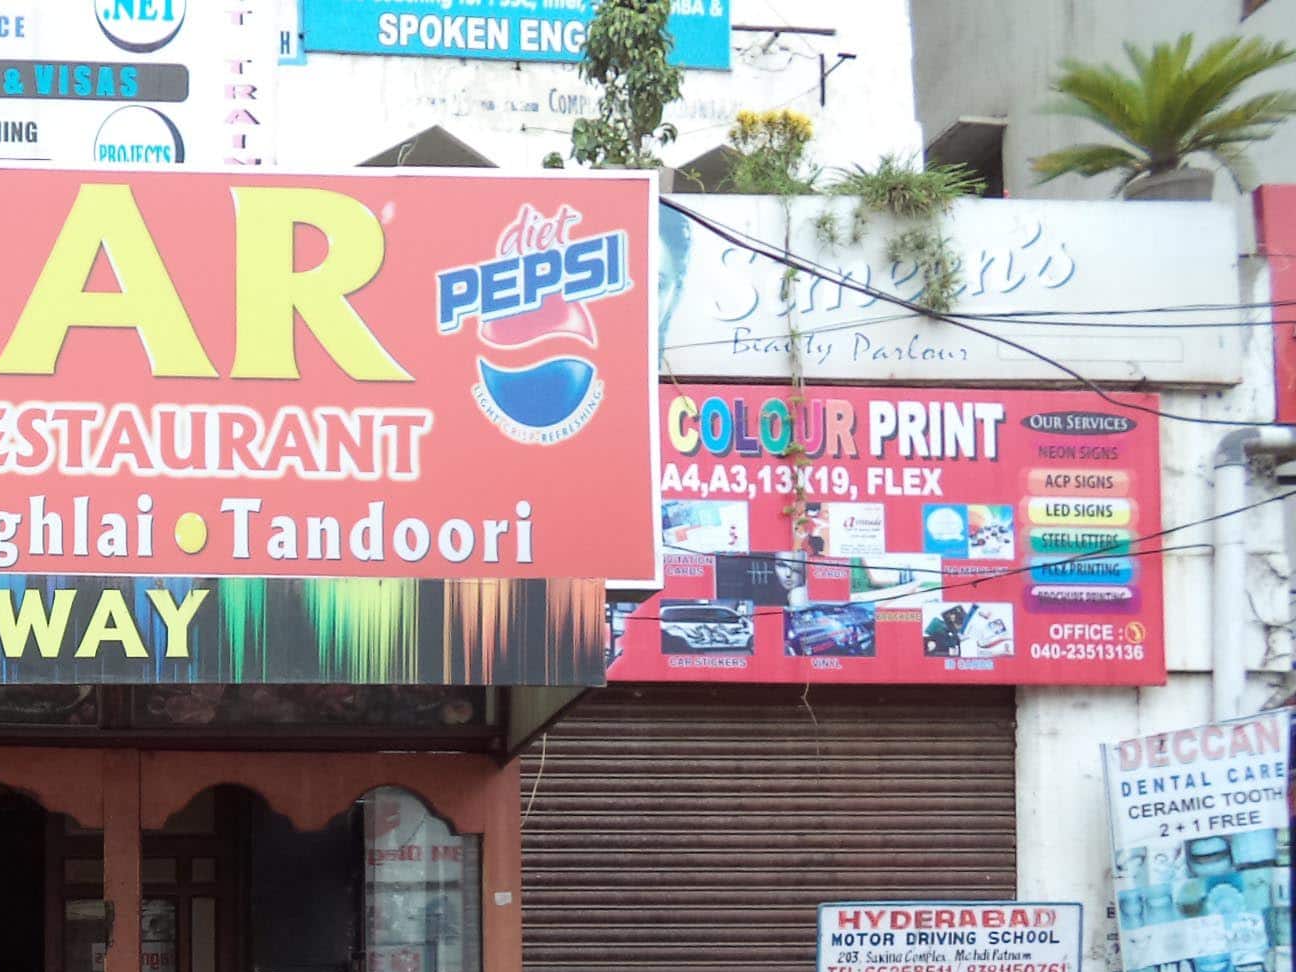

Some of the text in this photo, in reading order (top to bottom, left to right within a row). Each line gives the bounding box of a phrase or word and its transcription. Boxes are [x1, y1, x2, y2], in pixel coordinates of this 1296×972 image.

[378, 13, 592, 52] SPOKEN ENG
[4, 68, 24, 95] &
[35, 64, 138, 97] VISAS
[498, 204, 583, 256] diet
[437, 232, 625, 333] PEPSI
[852, 331, 978, 362] Parlour
[667, 395, 1007, 460] COLOUR PRINT
[1038, 444, 1119, 460] NEON SIGNS
[867, 467, 943, 496] FLEX
[1045, 474, 1114, 489] ACP SIGNS
[1046, 504, 1113, 518] LED SIGNS
[220, 498, 534, 563] Tandoori
[1041, 533, 1072, 548] STEEL
[1069, 563, 1121, 577] PRINTING
[1049, 624, 1113, 641] OFFICE
[1030, 643, 1144, 661] 040-23513136
[1119, 720, 1281, 772] DECCAN
[1121, 762, 1285, 798] DENTAL CARE
[1128, 788, 1285, 820] CERAMIC TOOTH
[1160, 810, 1263, 837] 2 + 1 FREE
[838, 908, 1057, 930] HYDERABAD
[831, 930, 1061, 946] MOTOR DRIVING SCHOOL
